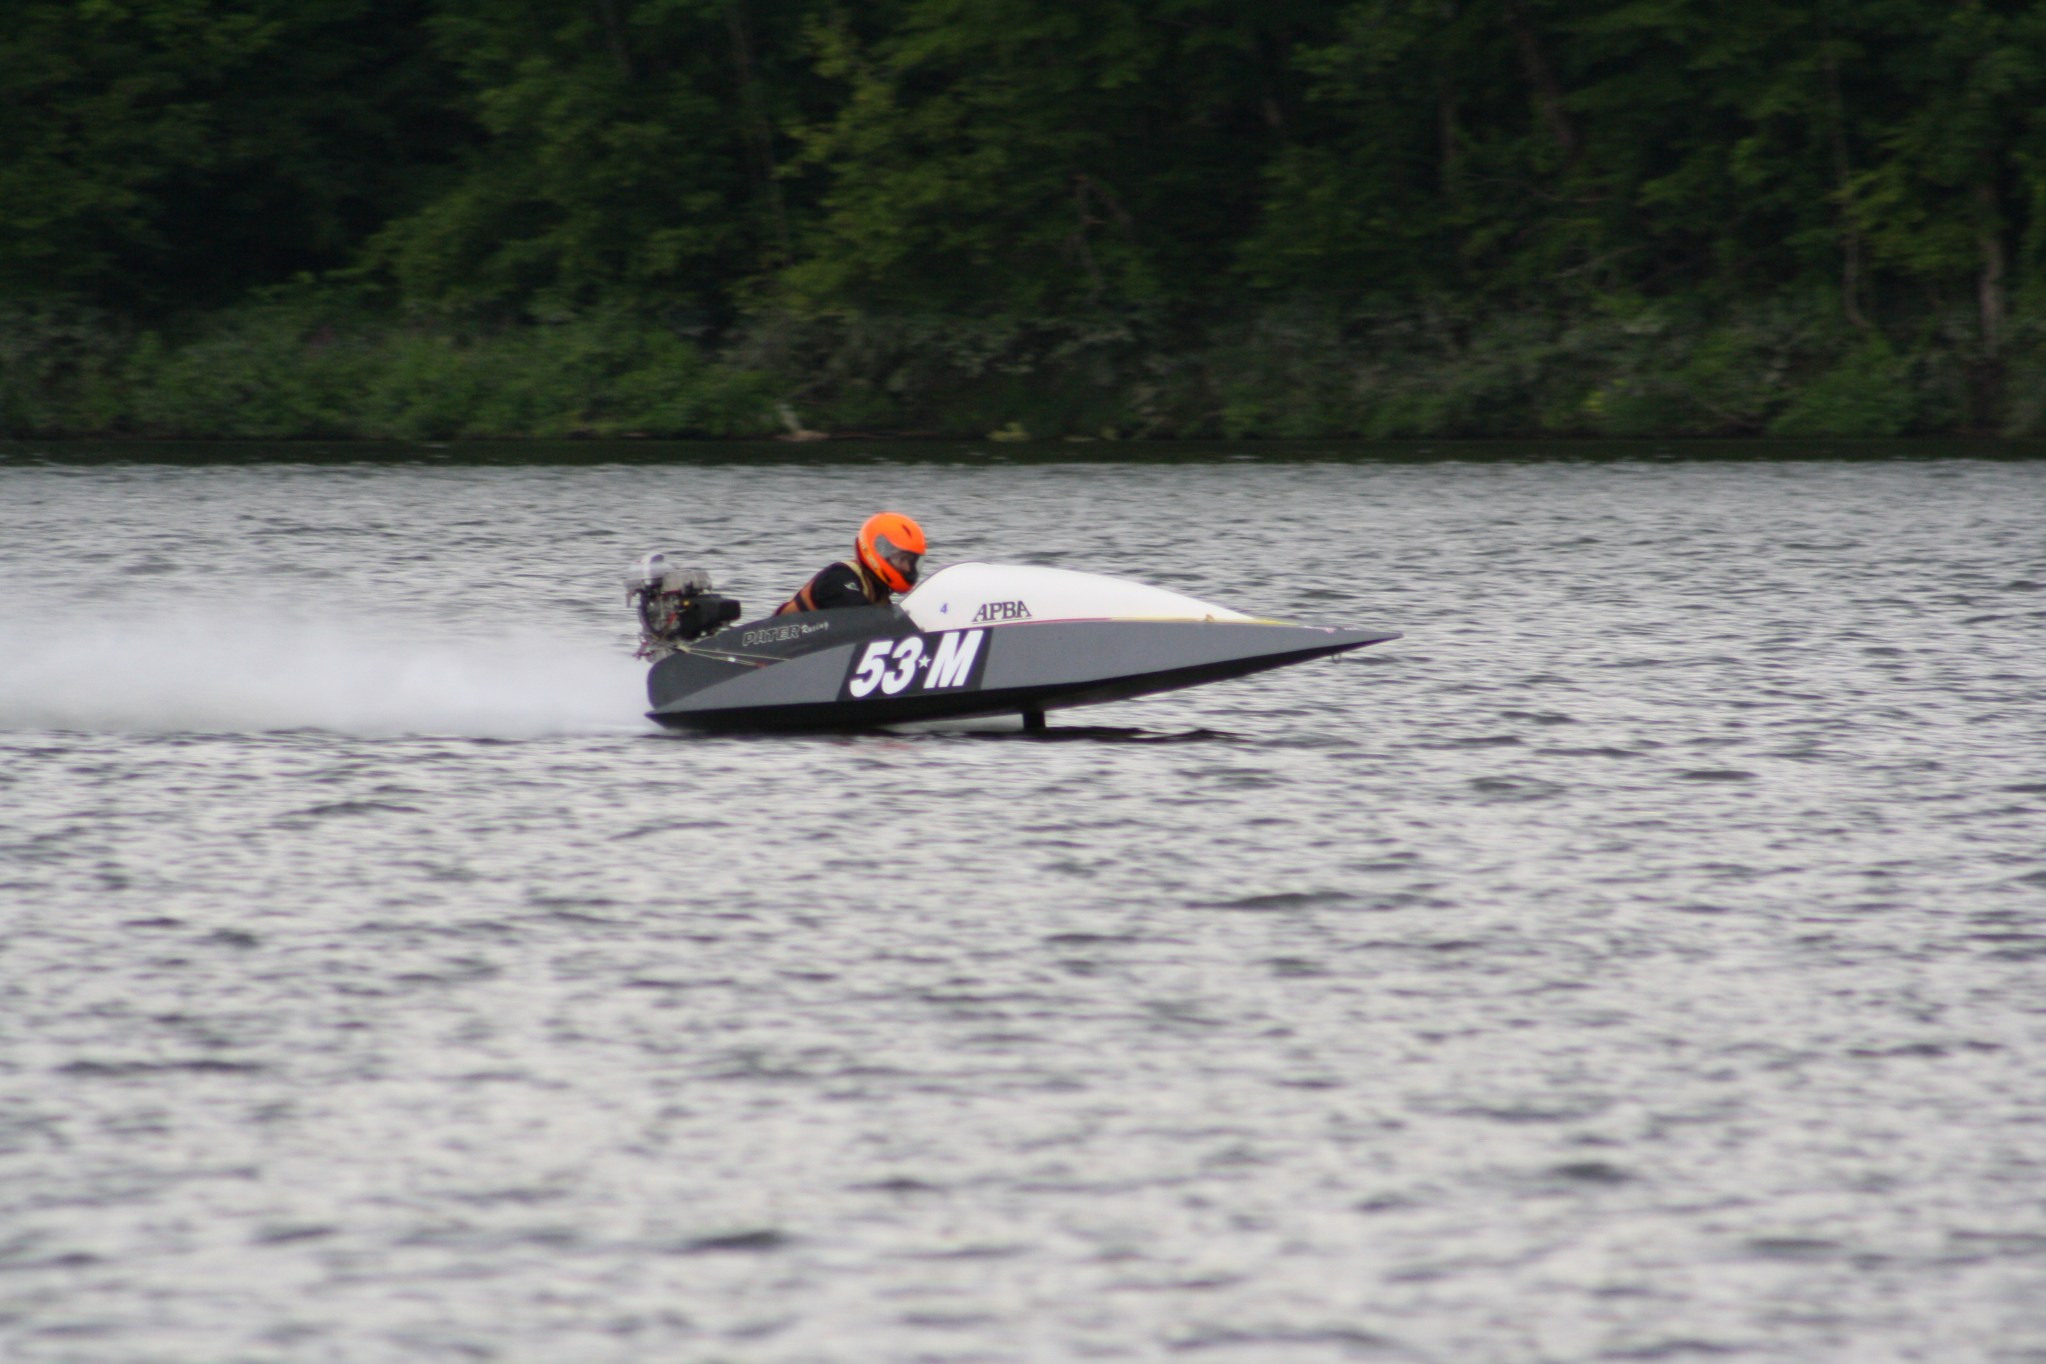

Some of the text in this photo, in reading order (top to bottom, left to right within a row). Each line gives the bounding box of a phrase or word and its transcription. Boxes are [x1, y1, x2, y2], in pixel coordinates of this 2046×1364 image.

[972, 601, 1032, 623] APBA
[742, 622, 829, 646] PATER Racing
